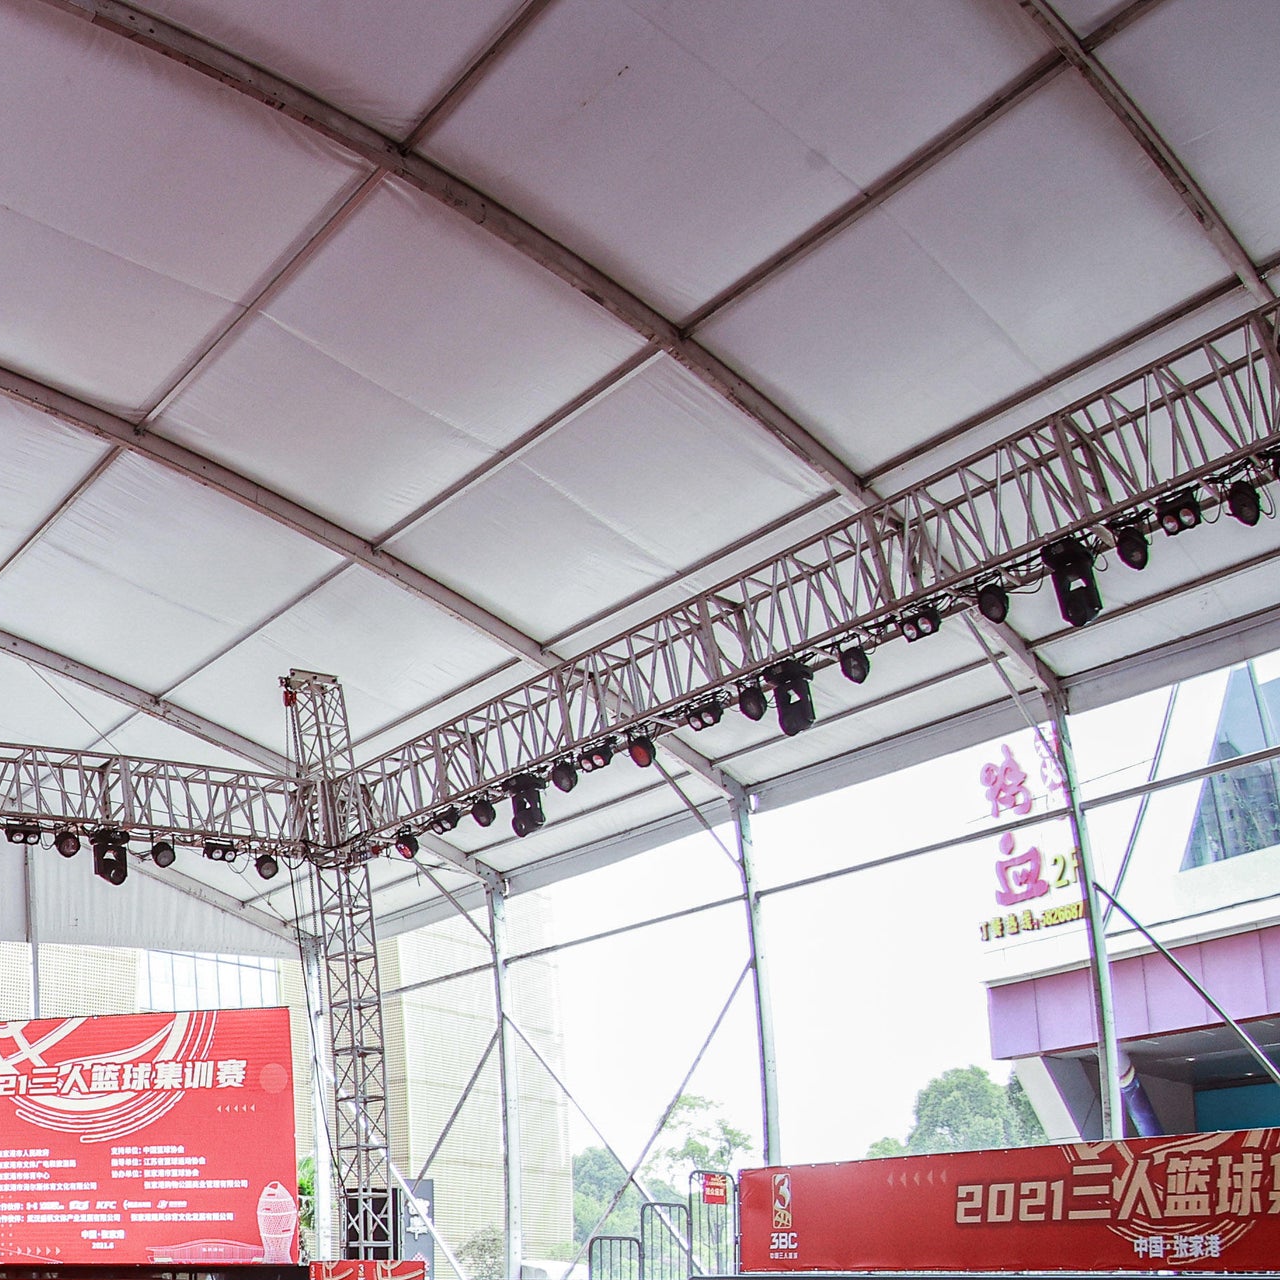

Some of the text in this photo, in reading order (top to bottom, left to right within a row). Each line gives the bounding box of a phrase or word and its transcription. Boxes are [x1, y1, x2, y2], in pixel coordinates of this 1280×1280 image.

[956, 1152, 1280, 1224] 2021三人篮球
[769, 1232, 798, 1250] 3BC
